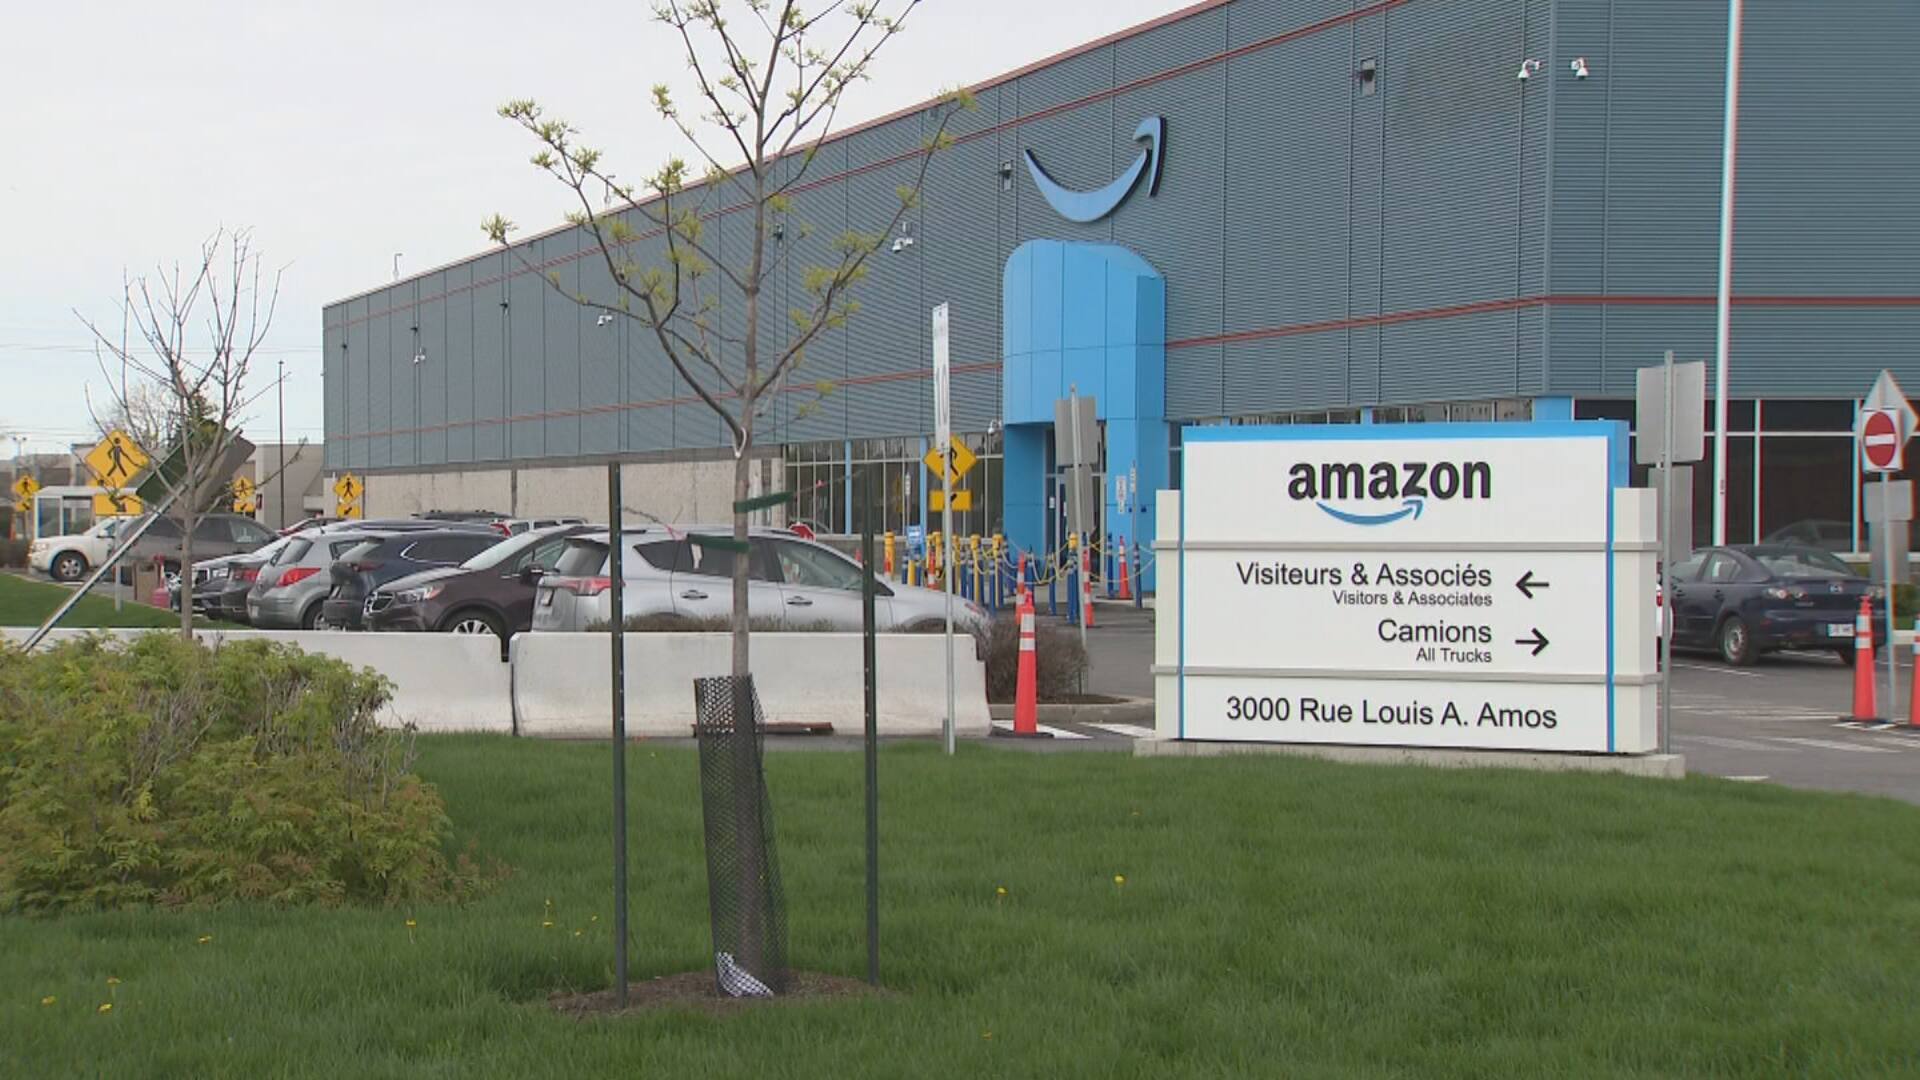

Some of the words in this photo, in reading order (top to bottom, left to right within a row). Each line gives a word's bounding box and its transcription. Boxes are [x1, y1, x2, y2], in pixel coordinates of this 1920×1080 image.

[1287, 461, 1492, 501] amazon
[1236, 561, 1343, 586] Visiteurs
[1351, 562, 1370, 587] &
[1375, 562, 1493, 587] Associés
[1332, 590, 1389, 606] Visitors
[1392, 590, 1405, 606] &
[1407, 590, 1493, 607] Associates
[1377, 618, 1493, 644] Camions
[1415, 647, 1436, 662] All
[1439, 647, 1493, 663] Trucks
[1226, 696, 1291, 722] 3000
[1300, 697, 1353, 724] Rue
[1362, 699, 1434, 726] Louis
[1440, 701, 1470, 727] A.
[1477, 701, 1558, 730] Amos
